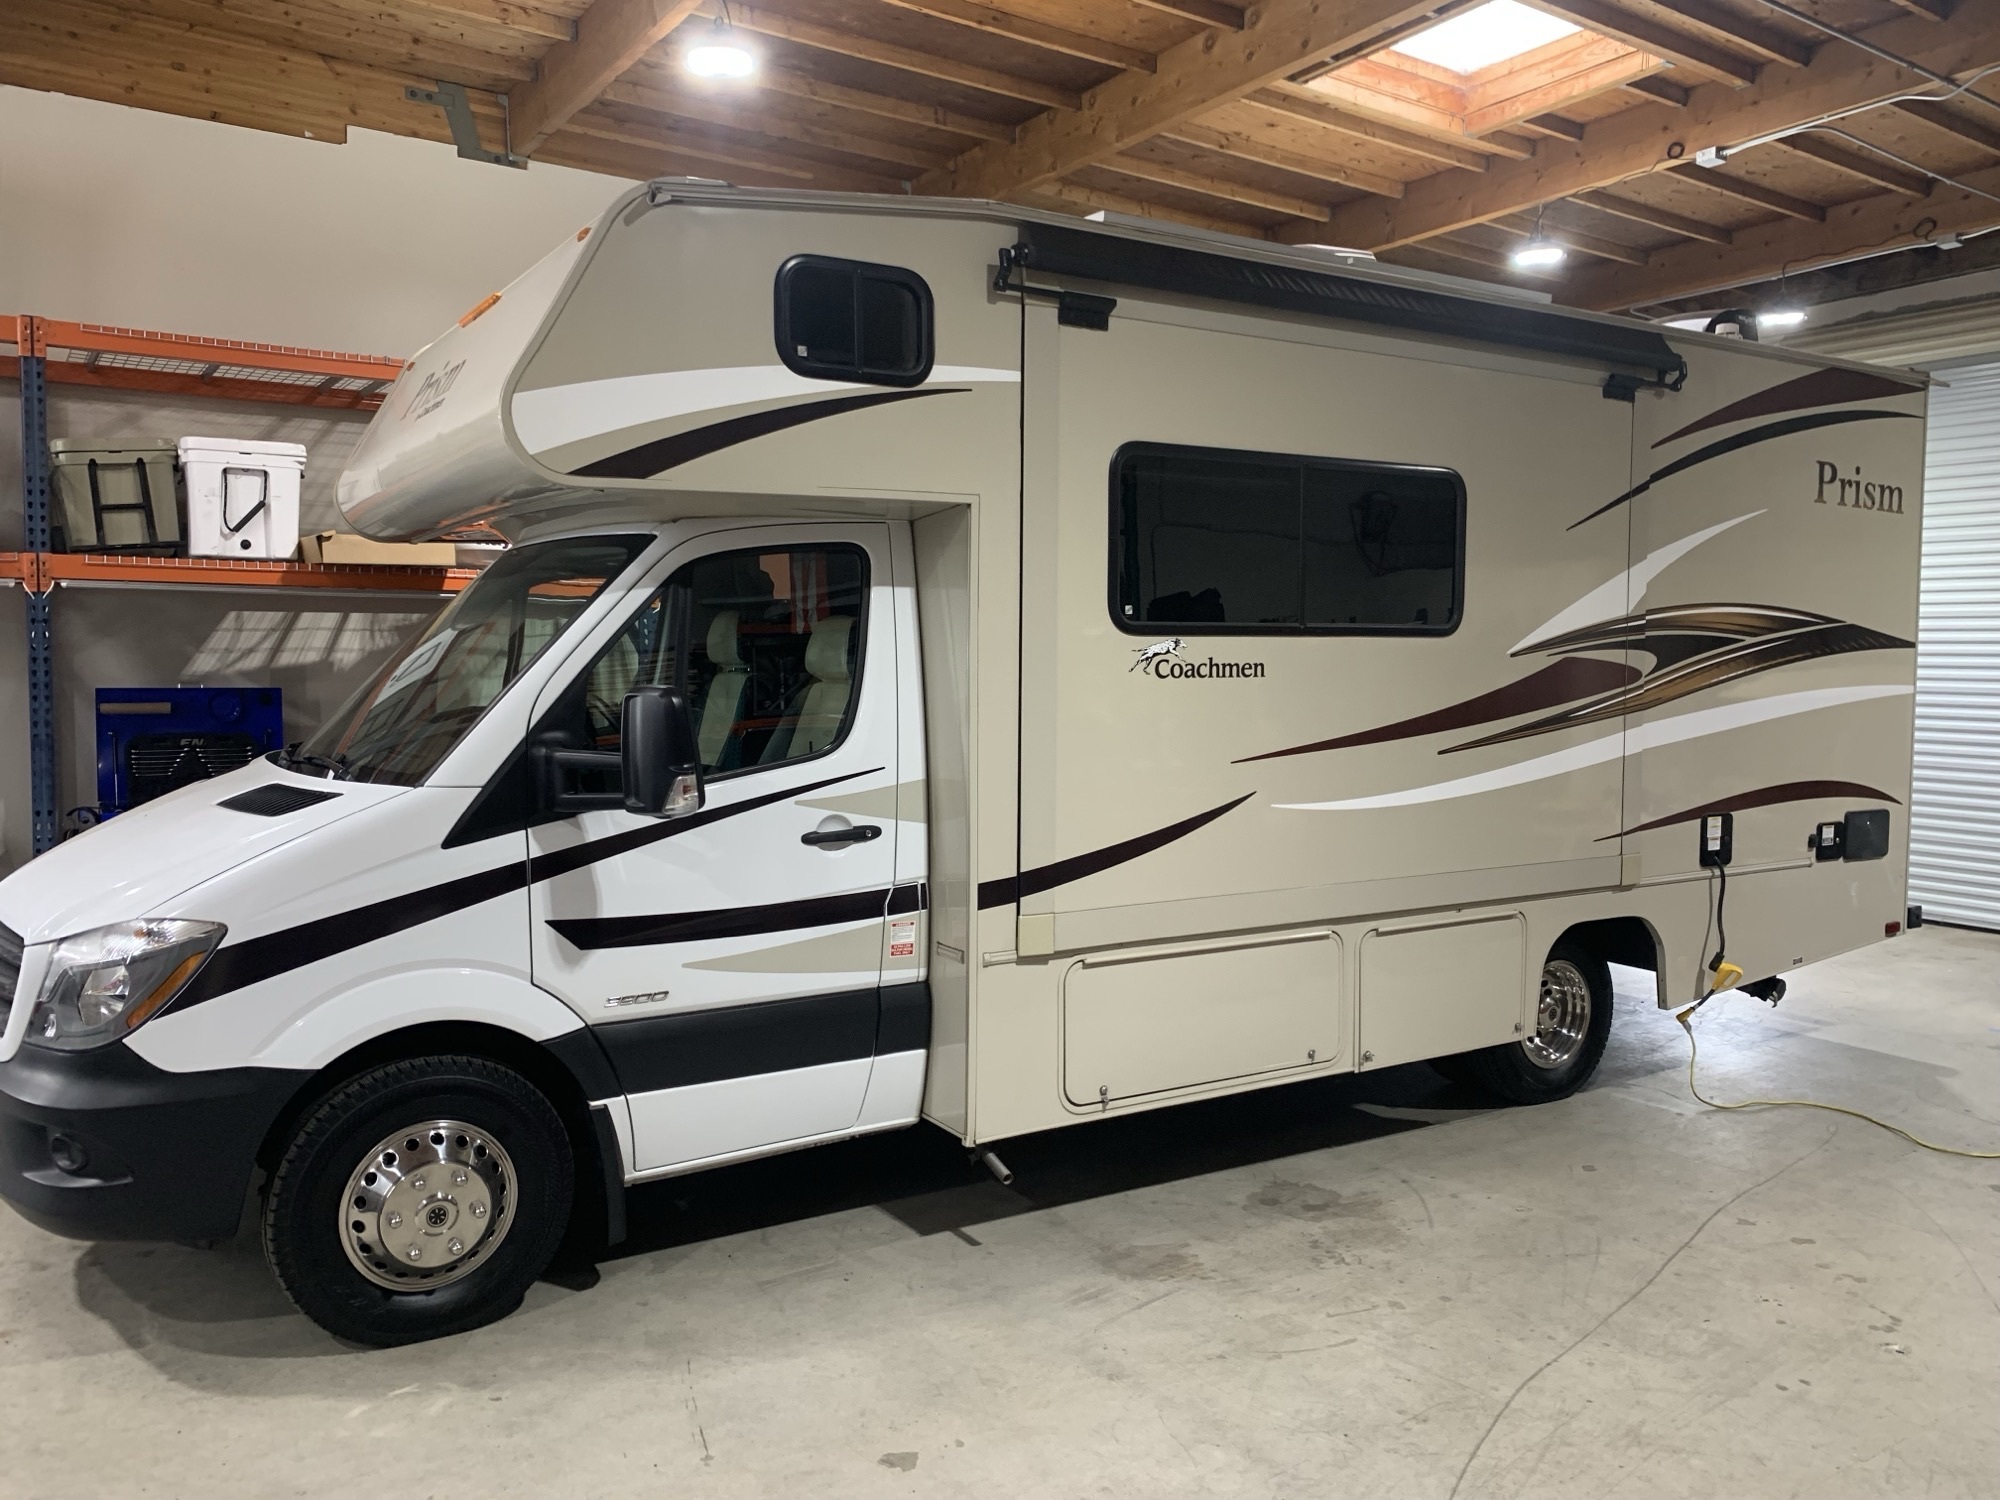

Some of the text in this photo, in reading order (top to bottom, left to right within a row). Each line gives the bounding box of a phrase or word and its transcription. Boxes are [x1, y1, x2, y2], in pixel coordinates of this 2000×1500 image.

[400, 359, 467, 421] Prism
[1814, 460, 1904, 514] Prism
[1154, 657, 1266, 679] Coachmen
